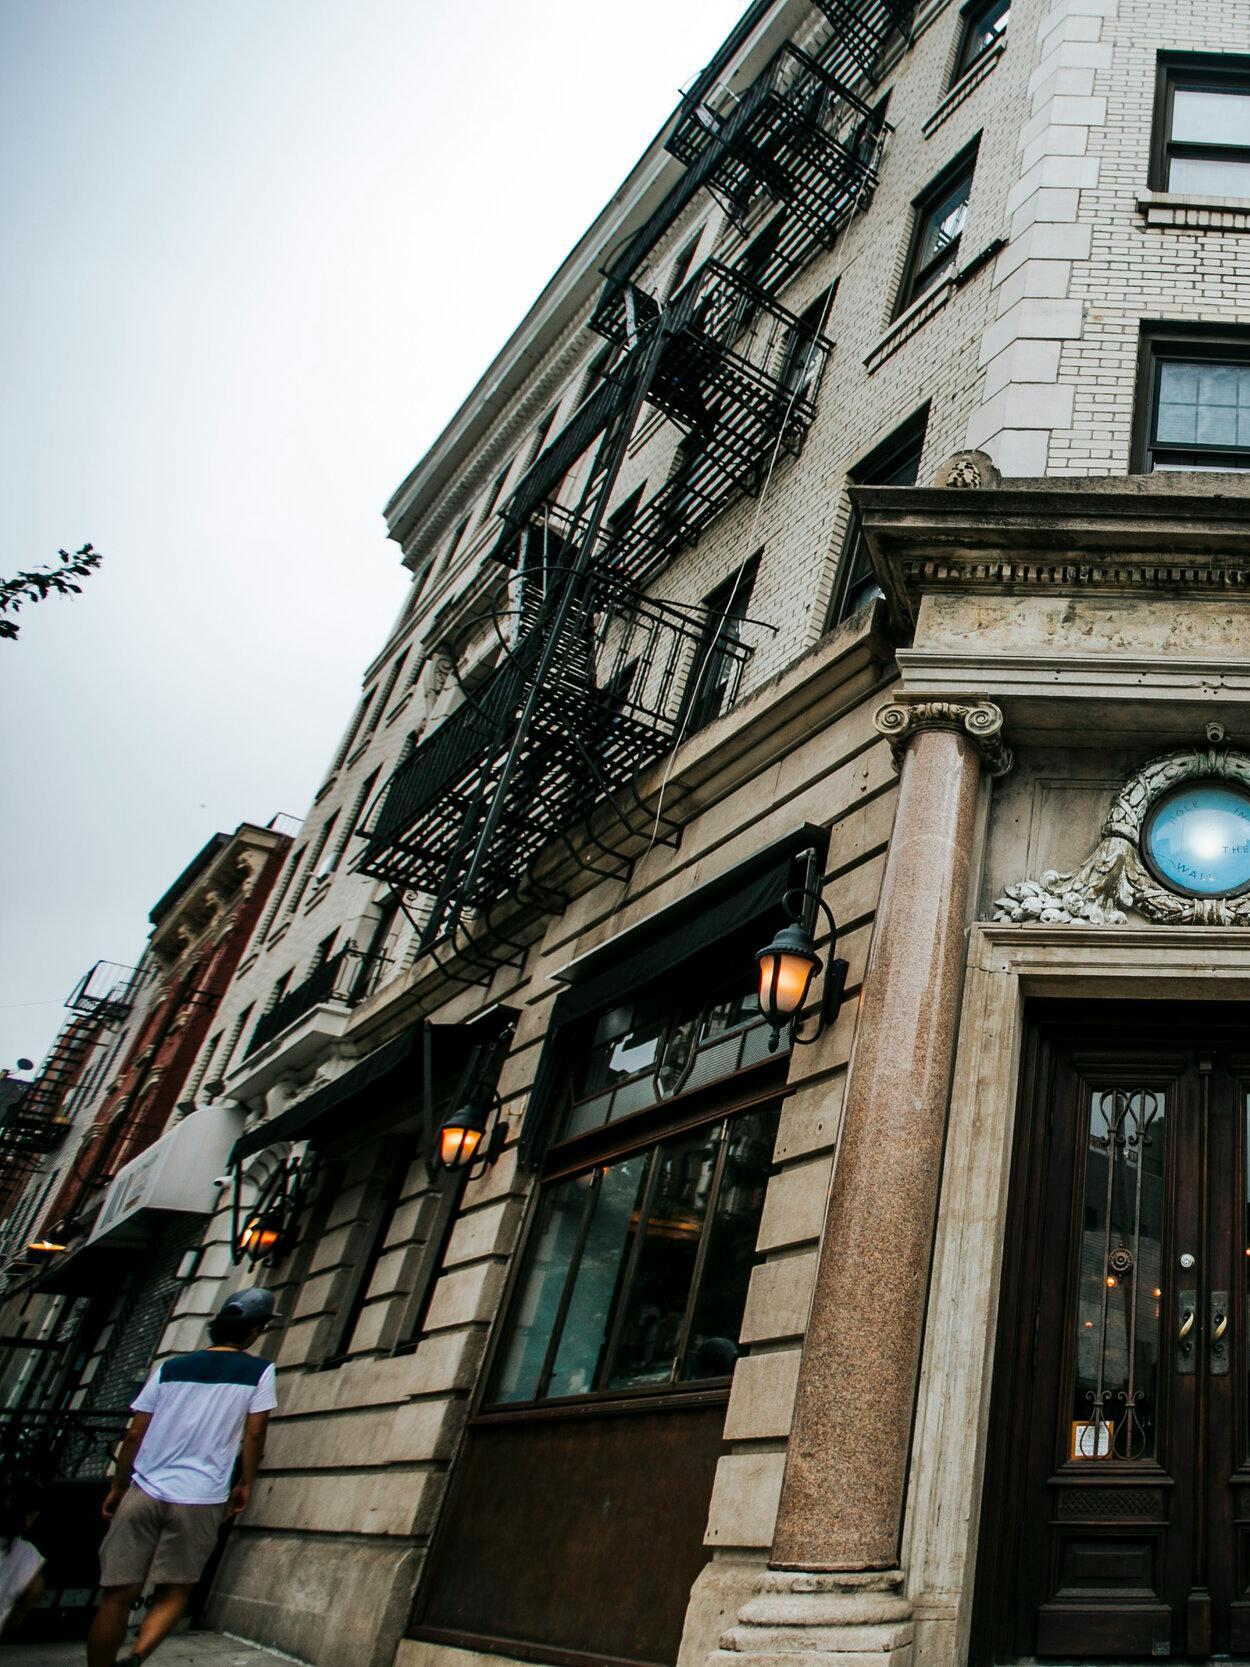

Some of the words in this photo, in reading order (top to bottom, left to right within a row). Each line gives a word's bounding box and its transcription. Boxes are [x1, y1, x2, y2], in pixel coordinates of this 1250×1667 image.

[1169, 802, 1199, 824] HOLE
[1233, 807, 1248, 819] IN
[1222, 845, 1249, 853] THE
